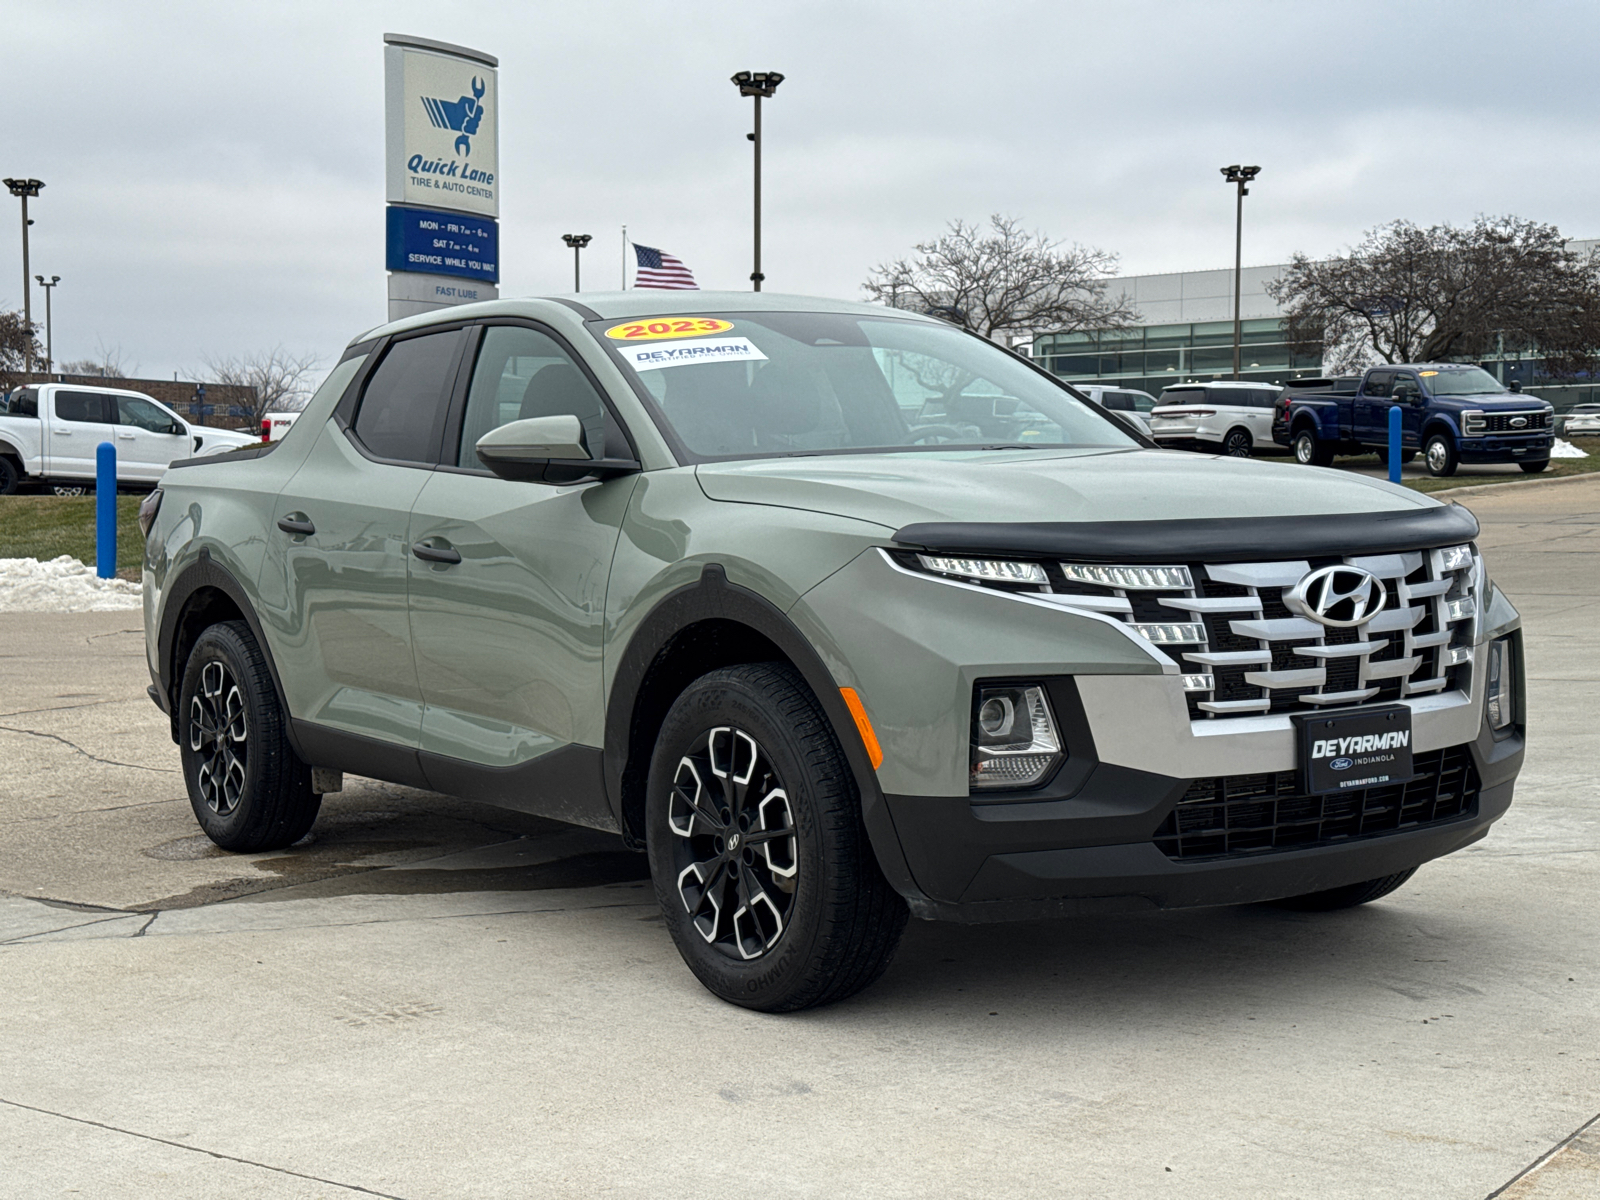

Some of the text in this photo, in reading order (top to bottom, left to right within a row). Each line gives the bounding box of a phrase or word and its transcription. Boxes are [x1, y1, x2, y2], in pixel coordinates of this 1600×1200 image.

[408, 154, 494, 185] Quick Lane
[410, 176, 493, 199] TIRE & AUTO CENTER
[420, 220, 438, 230] MON
[447, 223, 459, 233] FRI
[433, 238, 447, 248] SAT
[408, 253, 495, 272] SERVICE WHILE YOU WAIT
[436, 286, 478, 299] FAST LUBE
[622, 320, 722, 338] 2023
[637, 344, 749, 361] DEYARMAN
[648, 354, 697, 363] CERTIFIED
[1312, 730, 1409, 759] DEYARMAN
[1355, 754, 1395, 766] INDIANOLA
[747, 943, 796, 992] KUMHO
